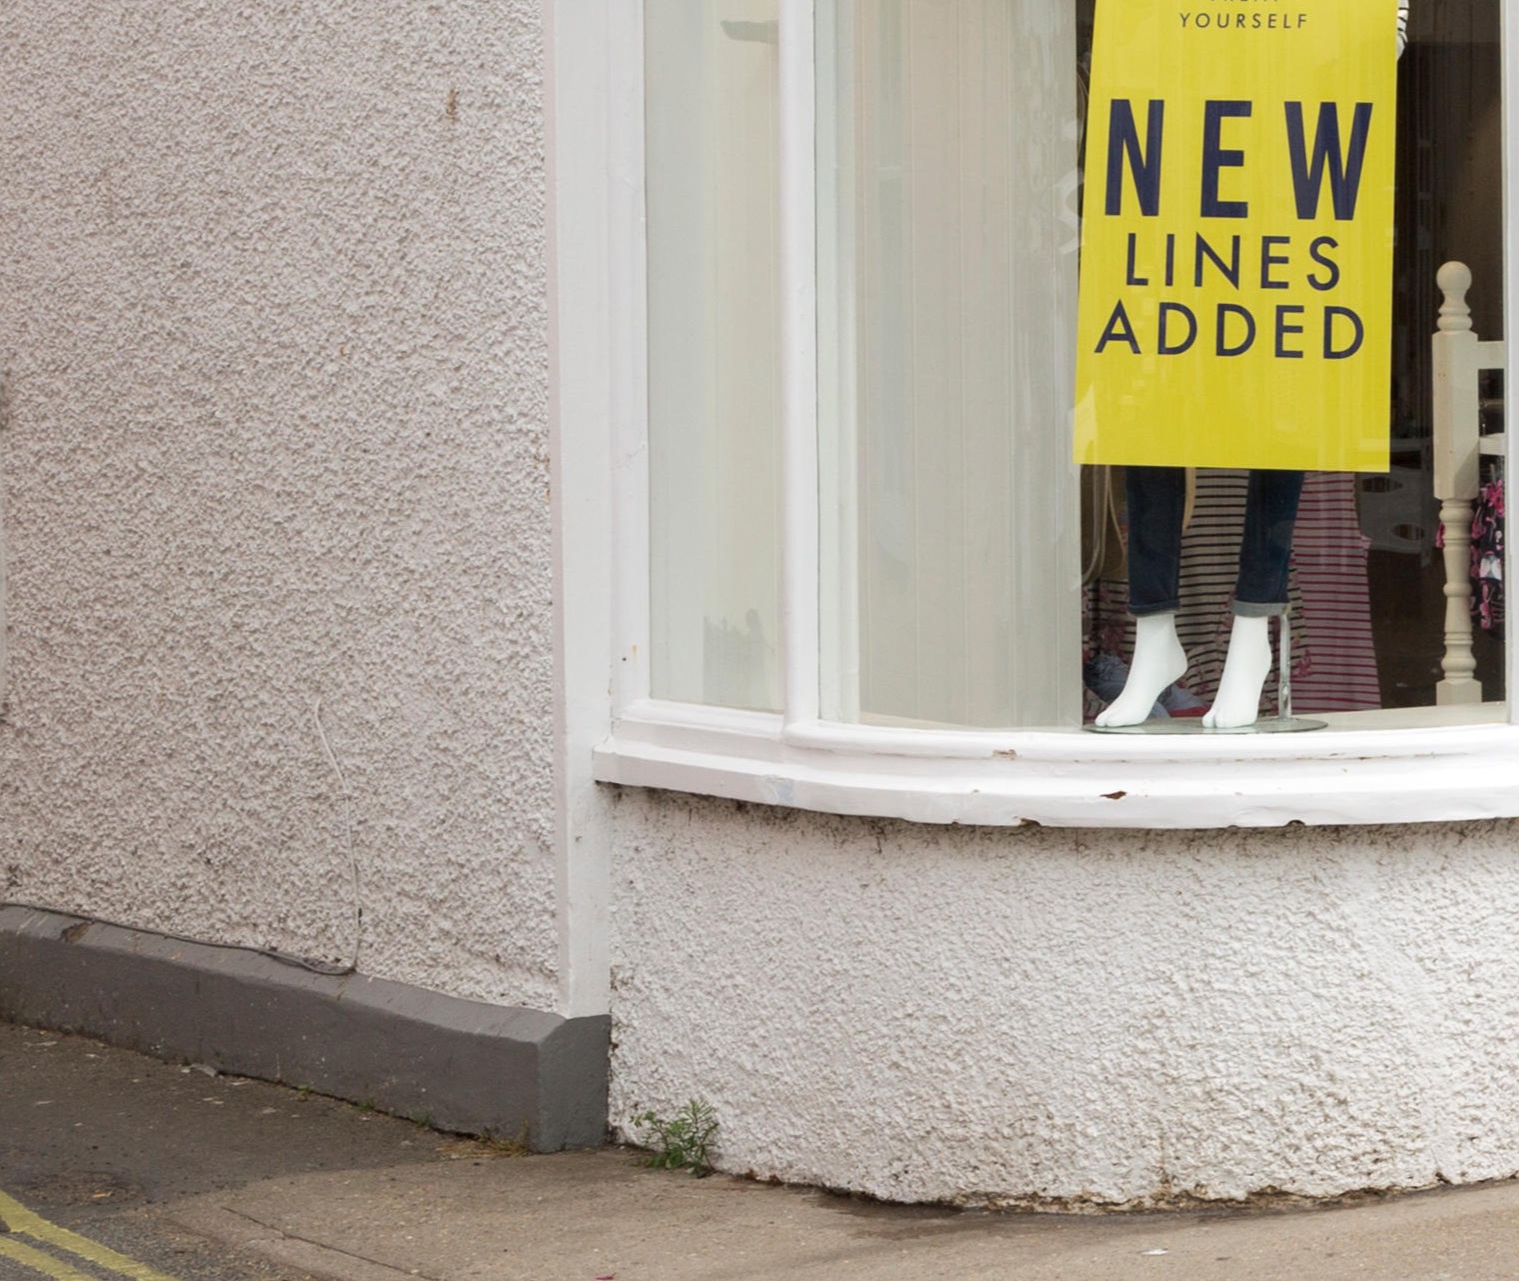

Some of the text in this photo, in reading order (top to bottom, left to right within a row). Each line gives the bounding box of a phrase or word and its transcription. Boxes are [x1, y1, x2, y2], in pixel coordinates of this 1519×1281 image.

[1179, 13, 1308, 29] YOURSELF
[1105, 99, 1374, 221] NEW
[1126, 232, 1341, 292] LINES
[1094, 300, 1365, 360] ADDED
